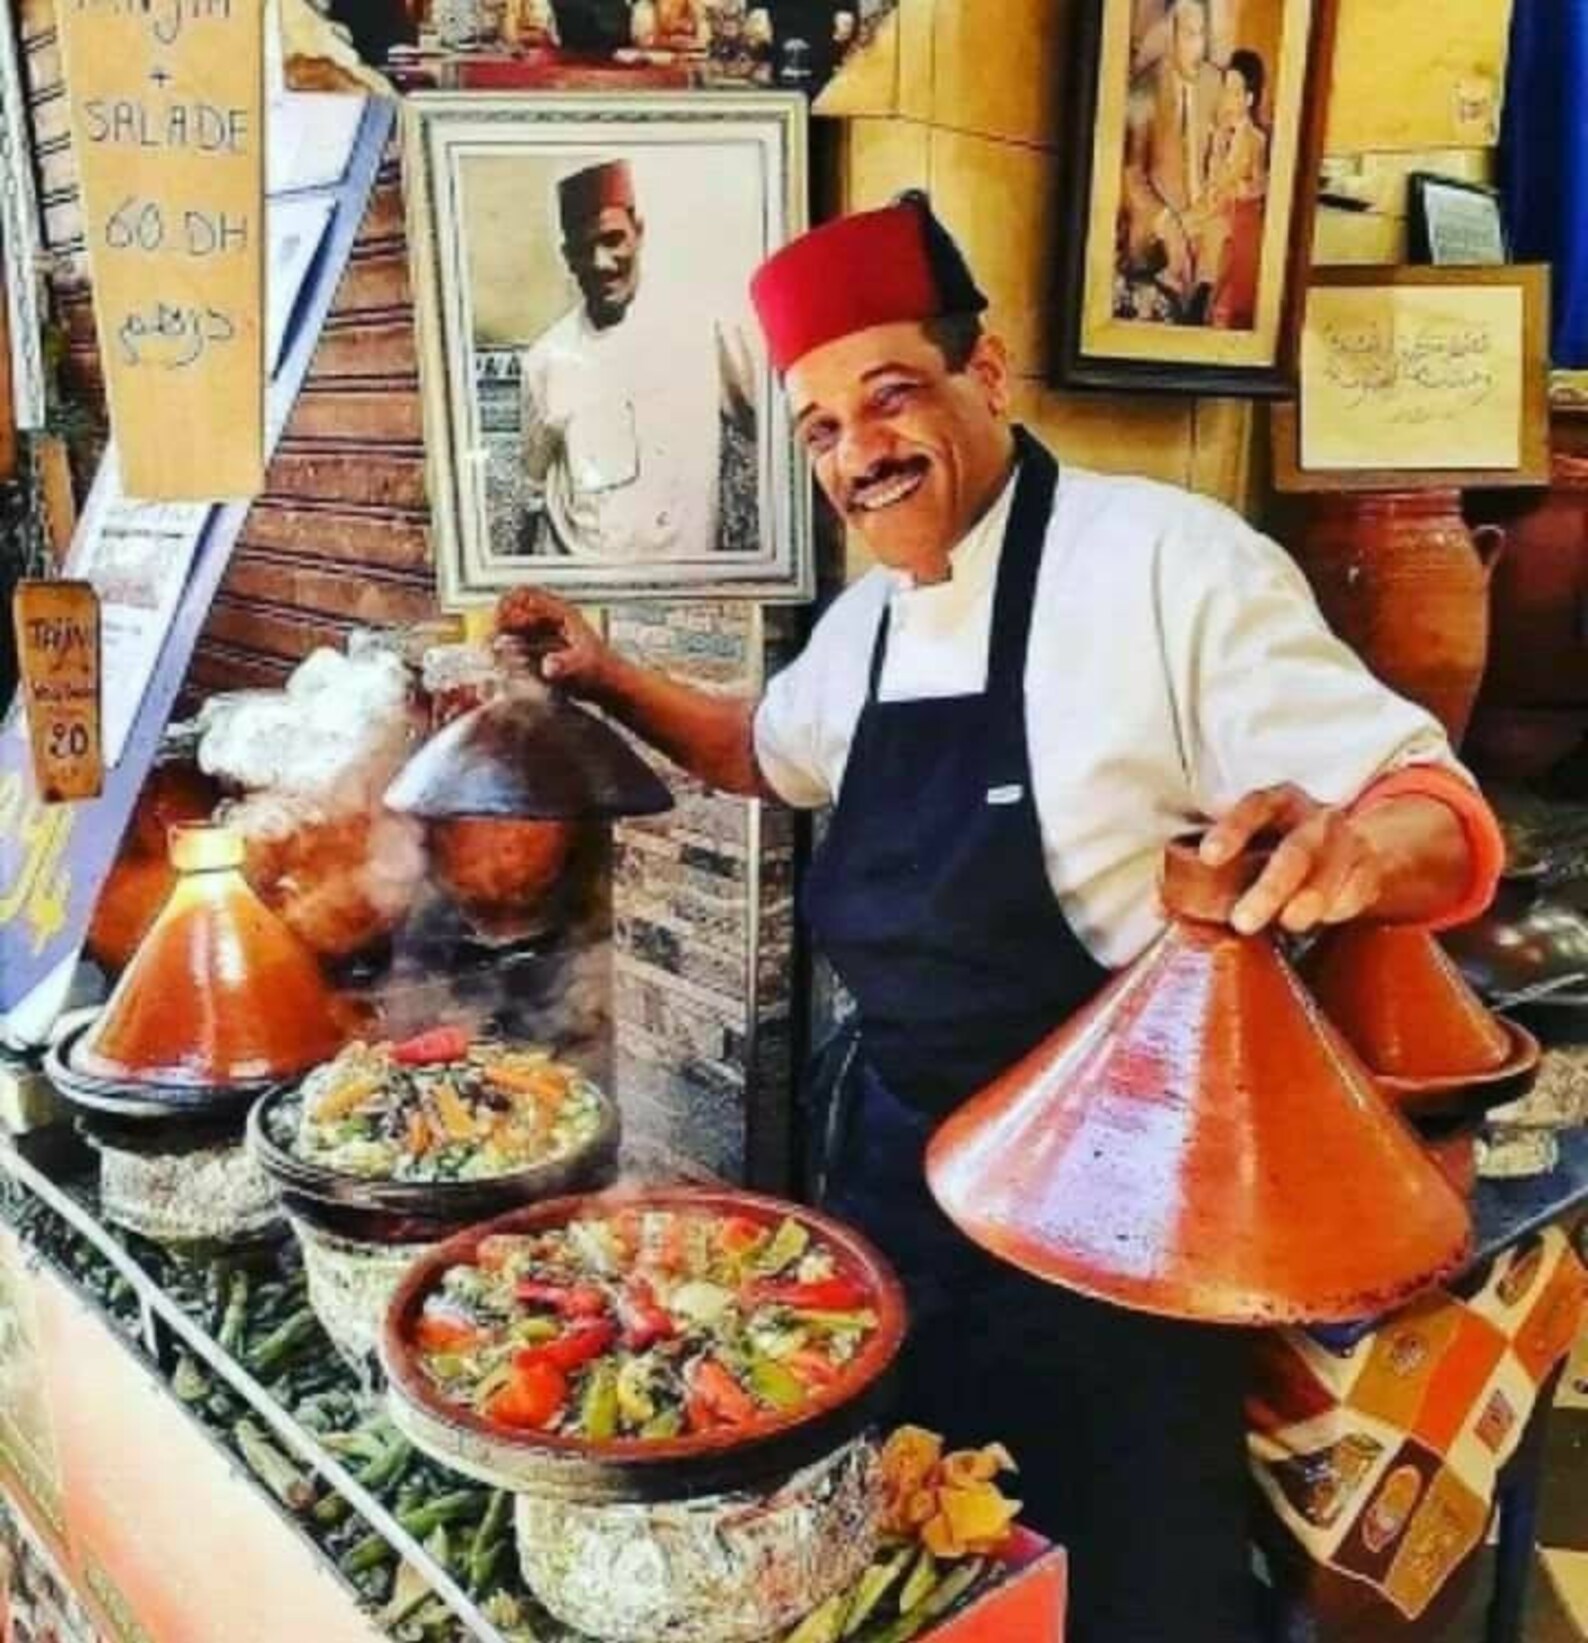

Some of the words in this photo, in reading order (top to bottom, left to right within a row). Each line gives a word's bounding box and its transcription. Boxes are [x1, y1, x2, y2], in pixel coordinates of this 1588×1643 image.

[84, 100, 249, 152] SALADE
[105, 198, 163, 250] 60
[184, 210, 249, 256] DH
